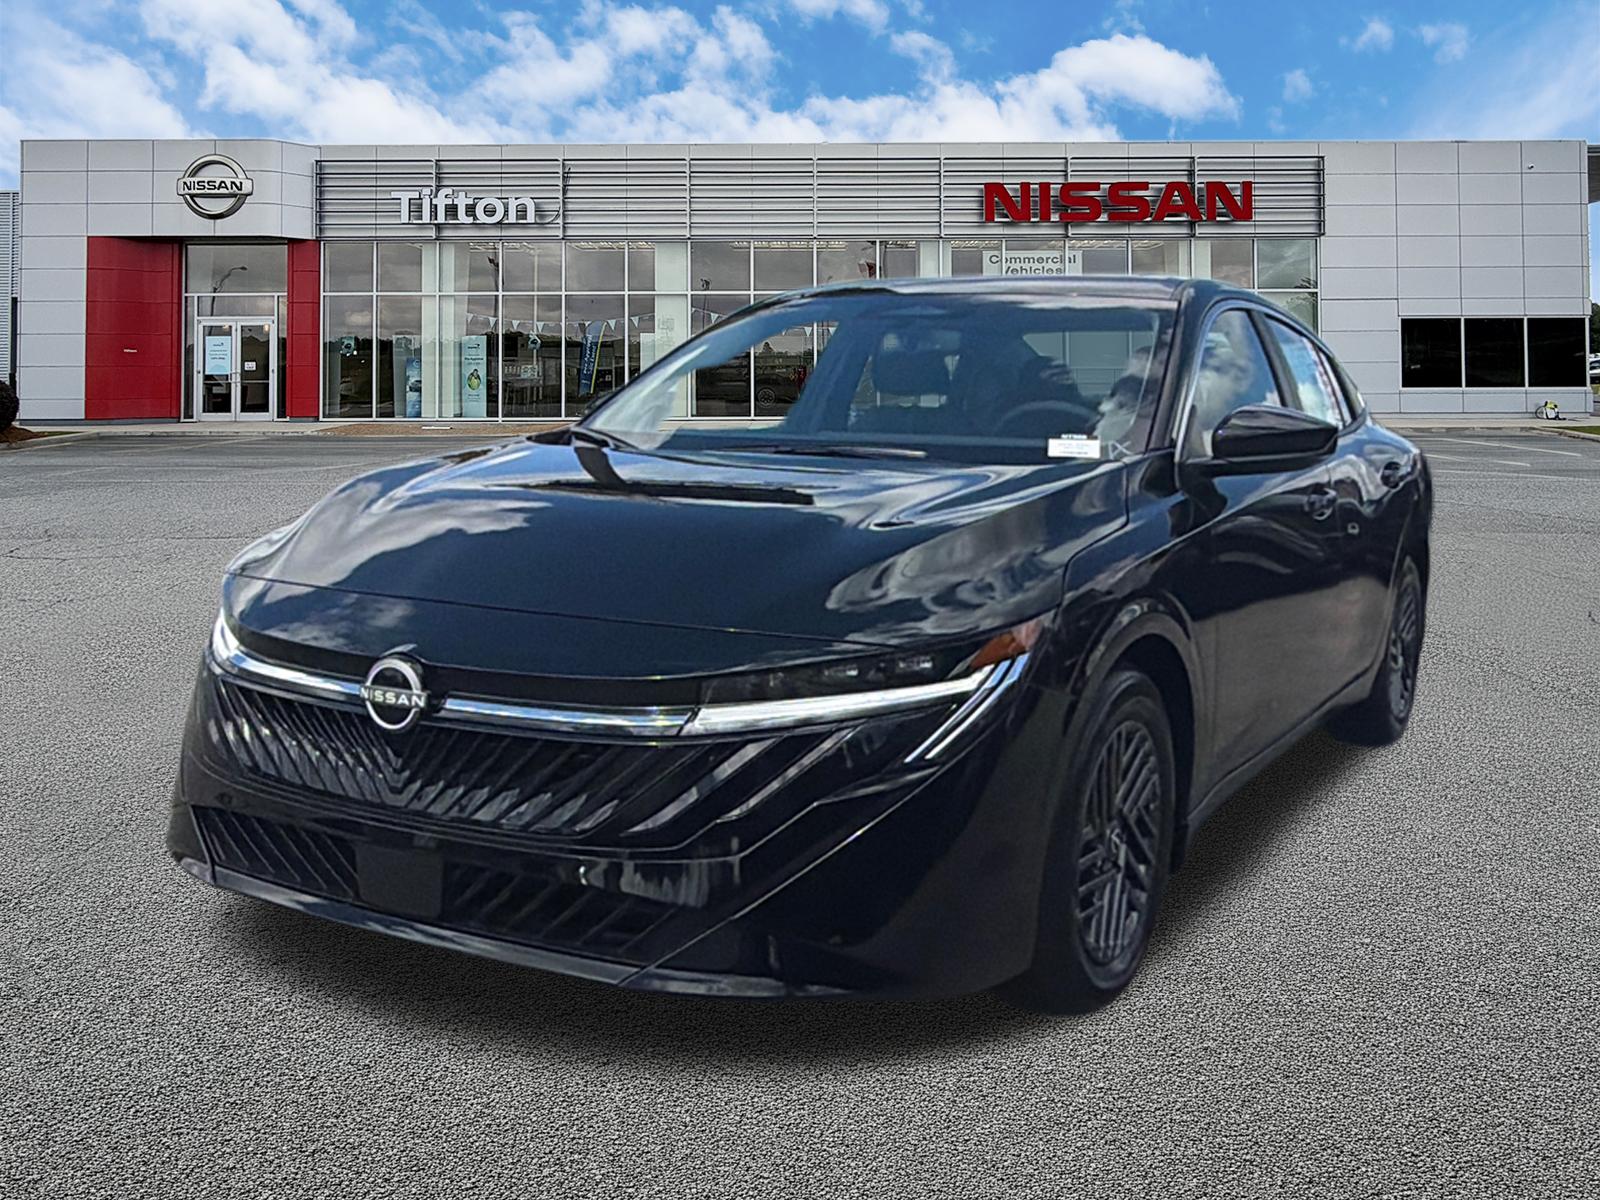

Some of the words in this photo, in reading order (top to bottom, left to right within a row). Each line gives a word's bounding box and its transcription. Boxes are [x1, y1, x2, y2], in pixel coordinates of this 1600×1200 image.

[183, 180, 243, 191] NISSAN
[390, 187, 536, 224] Tifton
[983, 180, 1254, 222] NISSAN
[360, 686, 425, 708] NISSAN
